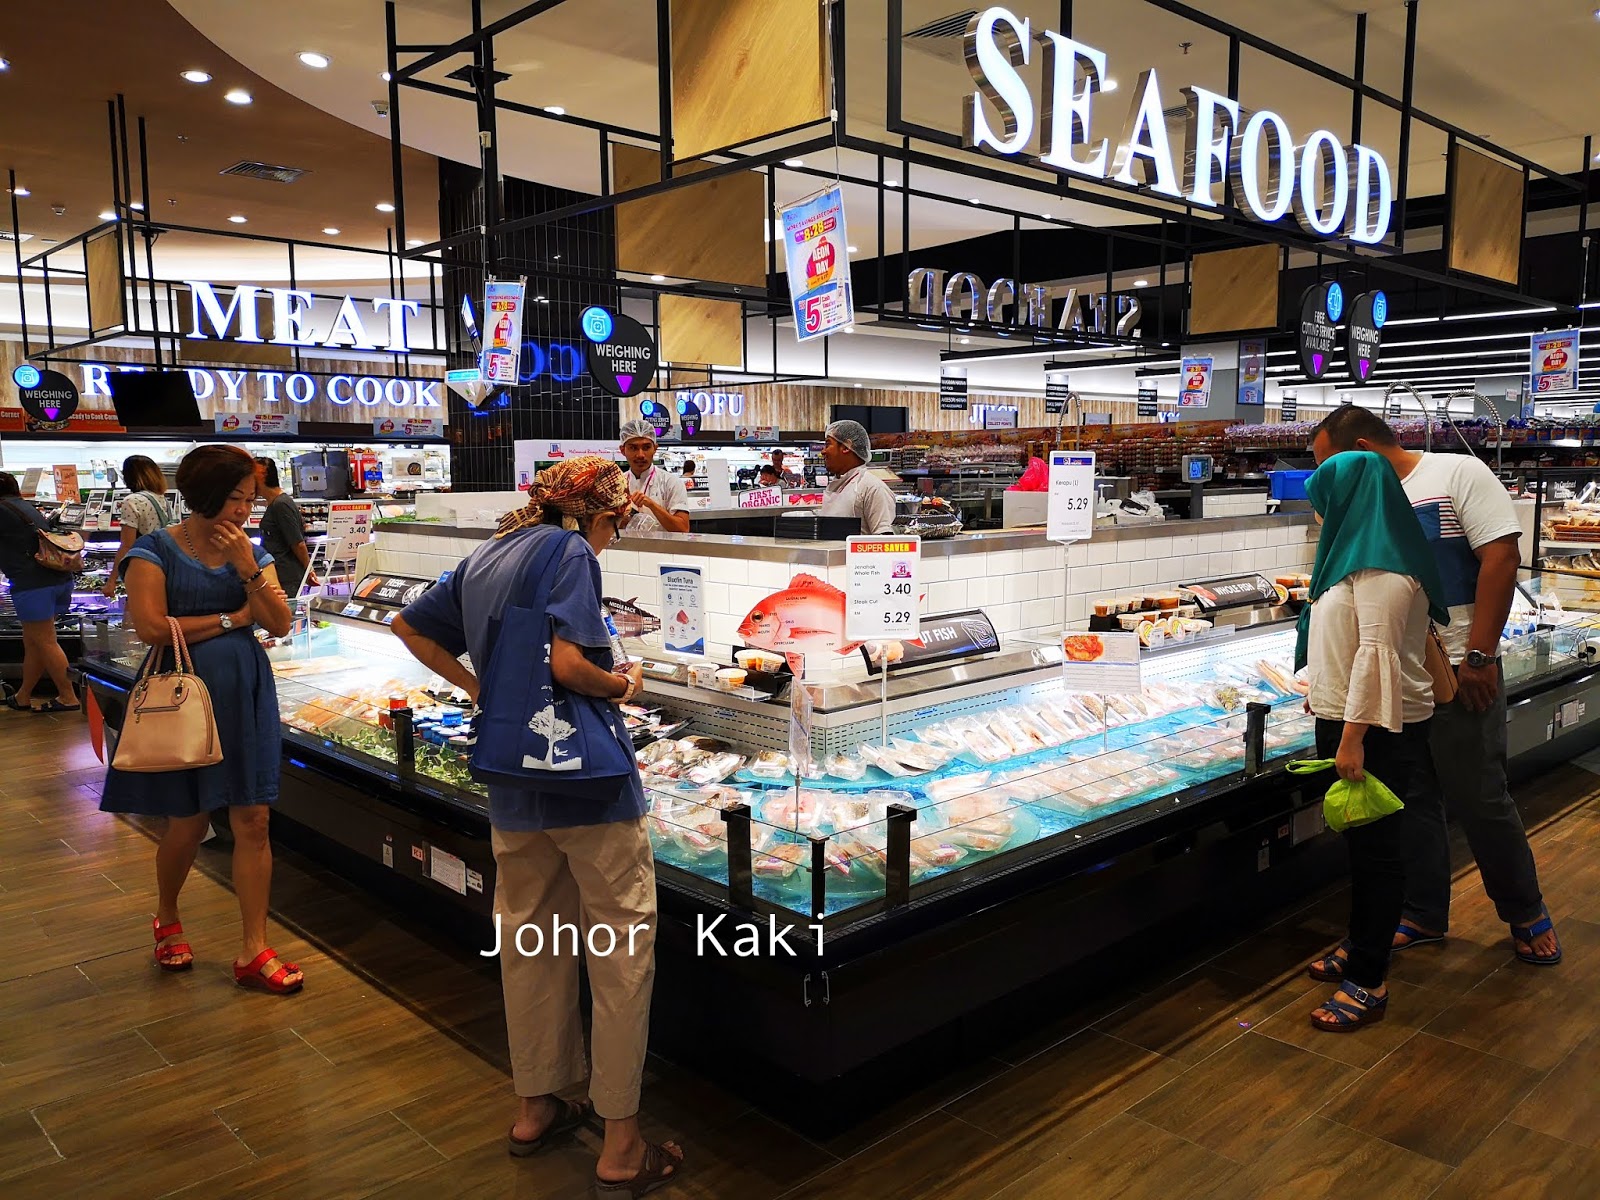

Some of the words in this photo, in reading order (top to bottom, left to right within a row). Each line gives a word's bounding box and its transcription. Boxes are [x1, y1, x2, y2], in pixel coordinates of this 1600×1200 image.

[963, 5, 1393, 245] SEAFOOD
[812, 245, 830, 262] AEON
[815, 259, 829, 276] DAY
[183, 281, 420, 353] MEAT
[806, 296, 822, 333] 5
[1313, 311, 1326, 324] FREE
[1301, 322, 1319, 336] CUTTING
[1319, 325, 1336, 340] SERVICE
[1351, 325, 1379, 343] WEIGHING
[595, 343, 651, 360] WEIGHING
[1305, 336, 1331, 352] AVAILABLE
[1357, 343, 1371, 358] HERE
[611, 359, 637, 373] HERE
[257, 371, 315, 403] TO
[327, 376, 441, 407] COOK
[1537, 376, 1551, 392] 5
[24, 390, 73, 399] WEIGHING
[39, 400, 61, 408] HERE
[676, 391, 744, 417] TOFU
[251, 420, 262, 432] 5
[741, 496, 780, 508] ORGANIC
[749, 489, 773, 501] FIRST
[1067, 498, 1088, 510] 5.29
[349, 526, 366, 534] 3.40
[856, 544, 883, 552] SUPER
[884, 543, 910, 552] SAVER
[883, 583, 911, 595] 3.40
[1212, 583, 1238, 595] WHOLE
[1238, 582, 1256, 592] FISH
[883, 612, 911, 623] 5.29
[932, 626, 958, 641] FISH
